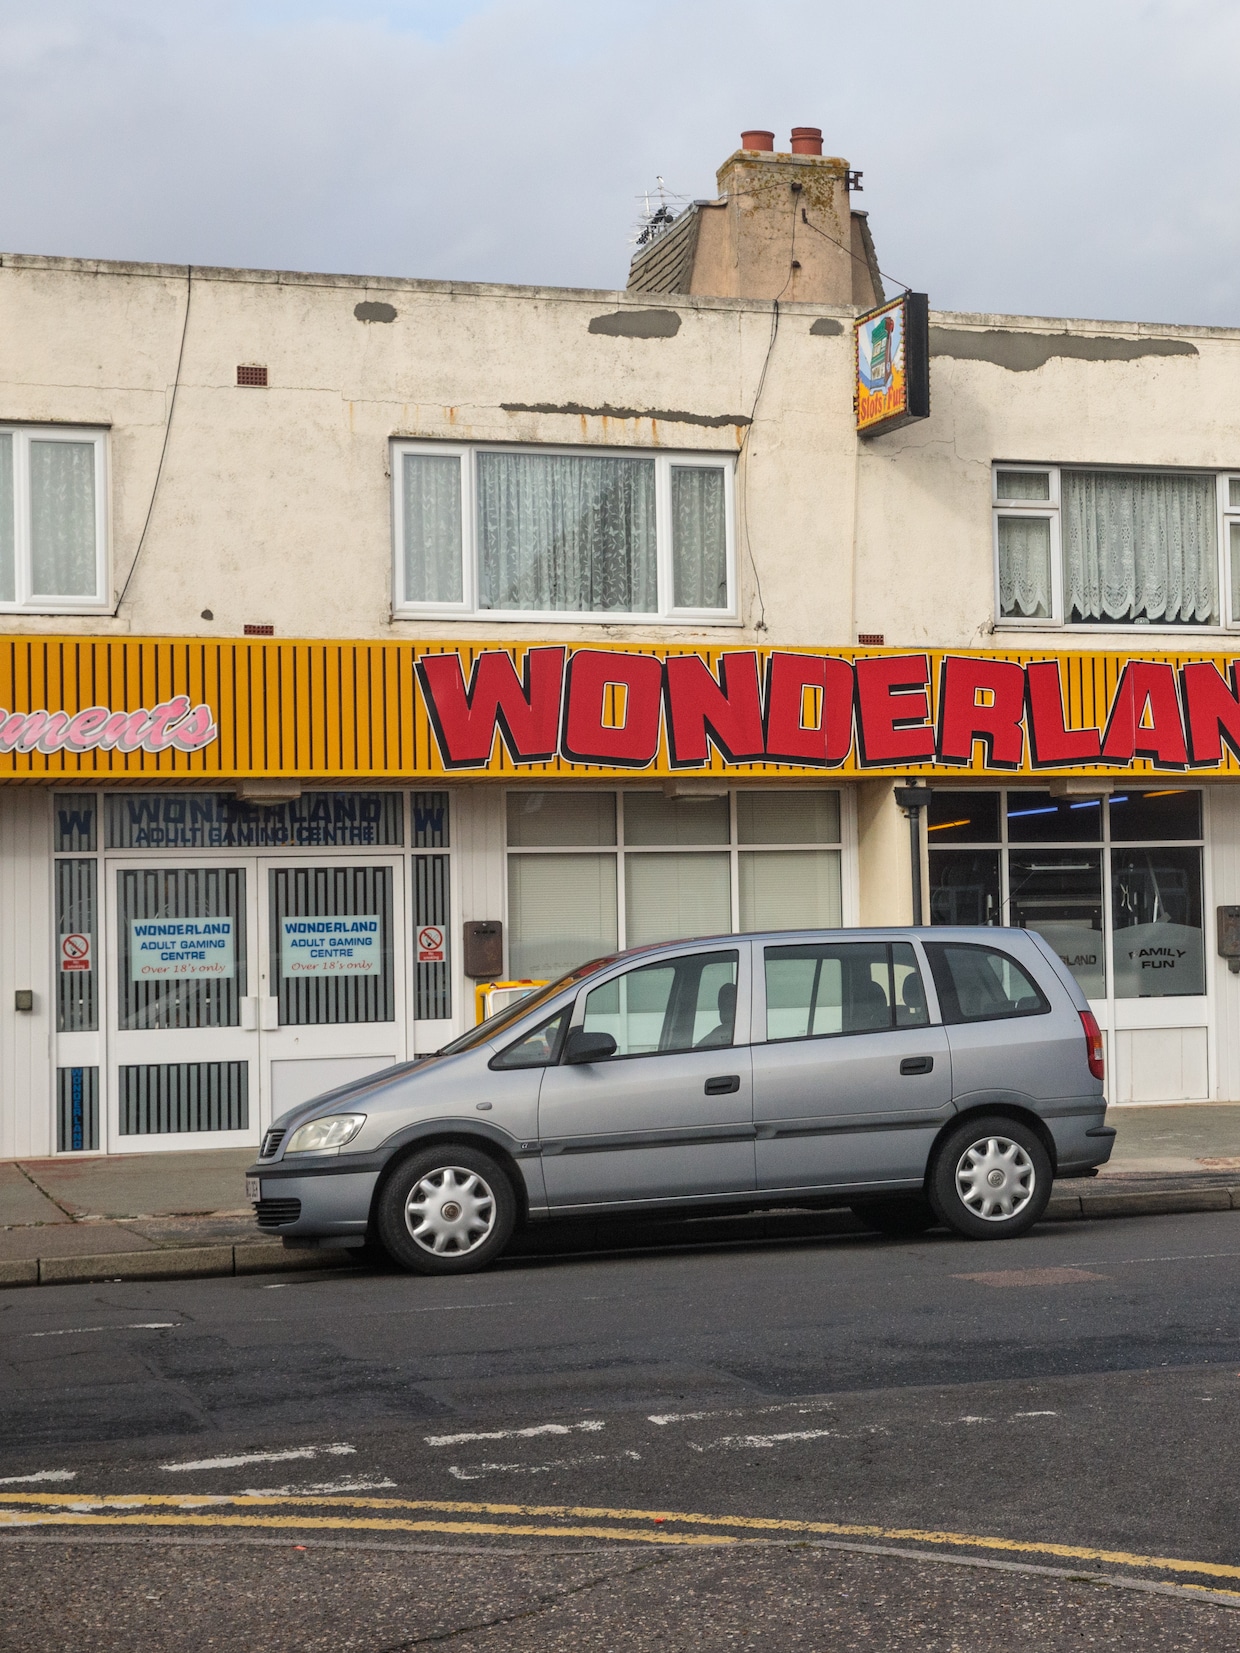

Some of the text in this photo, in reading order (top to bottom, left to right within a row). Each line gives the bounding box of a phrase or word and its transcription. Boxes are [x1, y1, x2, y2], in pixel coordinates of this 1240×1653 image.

[860, 386, 905, 421] Slots Fun
[0, 694, 218, 754] ments
[58, 810, 92, 835] W
[413, 807, 444, 832] W
[134, 825, 376, 844] ADULT GAMING CENTRE
[134, 923, 231, 937] WONDERLAND
[285, 921, 378, 934] WONDERLAND
[140, 939, 226, 951] ADULT GAMING
[290, 937, 373, 948] ADULT GAMING
[160, 951, 206, 961] CENTRE
[310, 948, 354, 958] CENTRE
[141, 965, 170, 975] Over
[198, 962, 226, 973] only
[291, 962, 320, 971] Over
[346, 959, 373, 971] only
[1141, 960, 1175, 969] FUN
[71, 1067, 83, 1150] WONDERLAND
